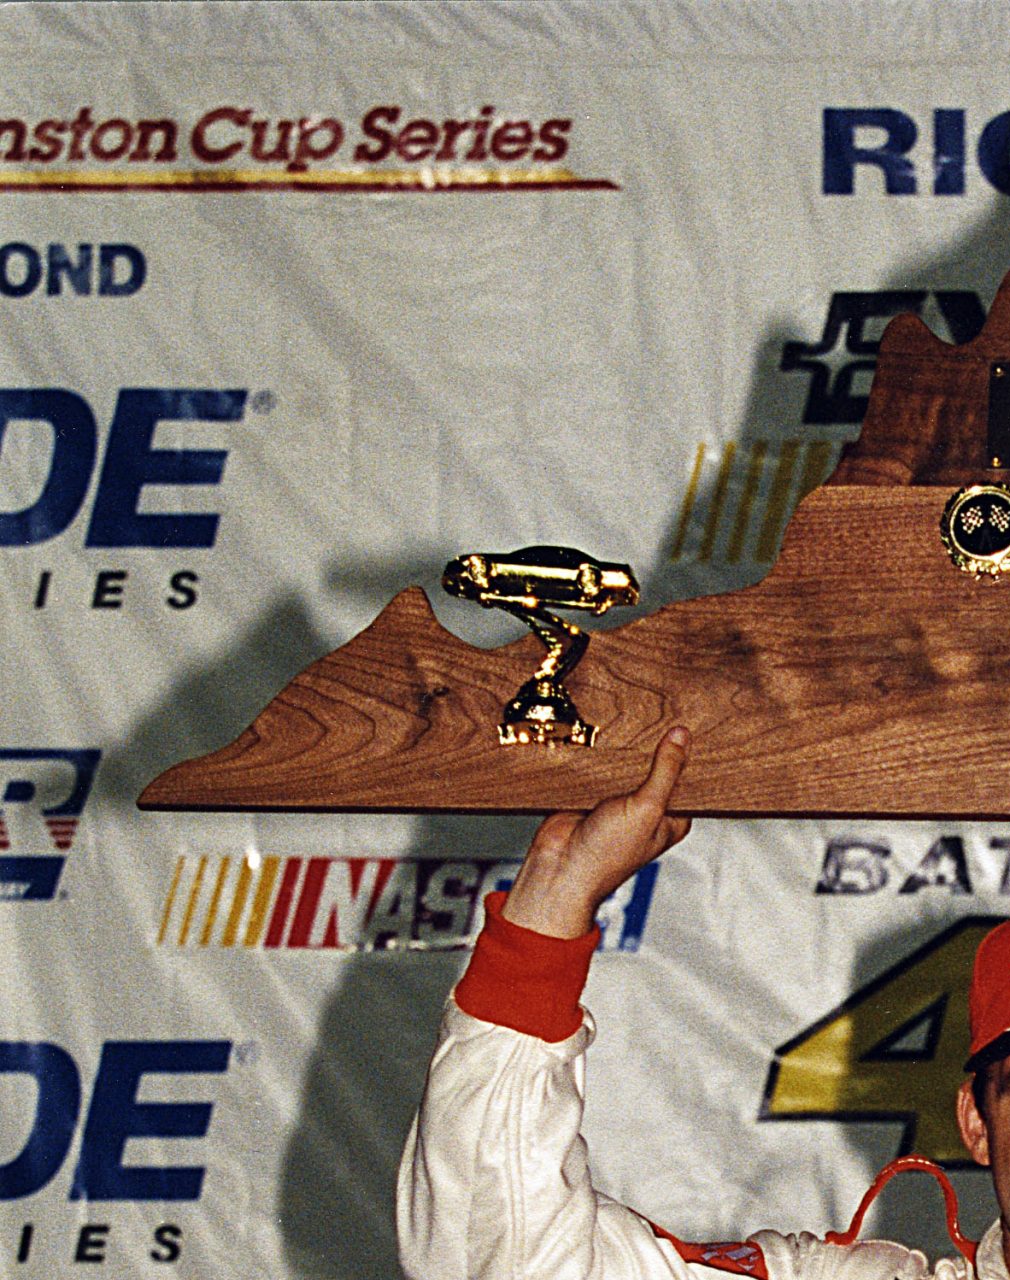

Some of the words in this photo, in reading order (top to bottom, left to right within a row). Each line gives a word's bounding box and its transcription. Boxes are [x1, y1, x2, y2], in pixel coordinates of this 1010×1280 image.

[191, 107, 345, 172] Cup
[354, 107, 572, 164] Series
[308, 857, 642, 951] NAS
